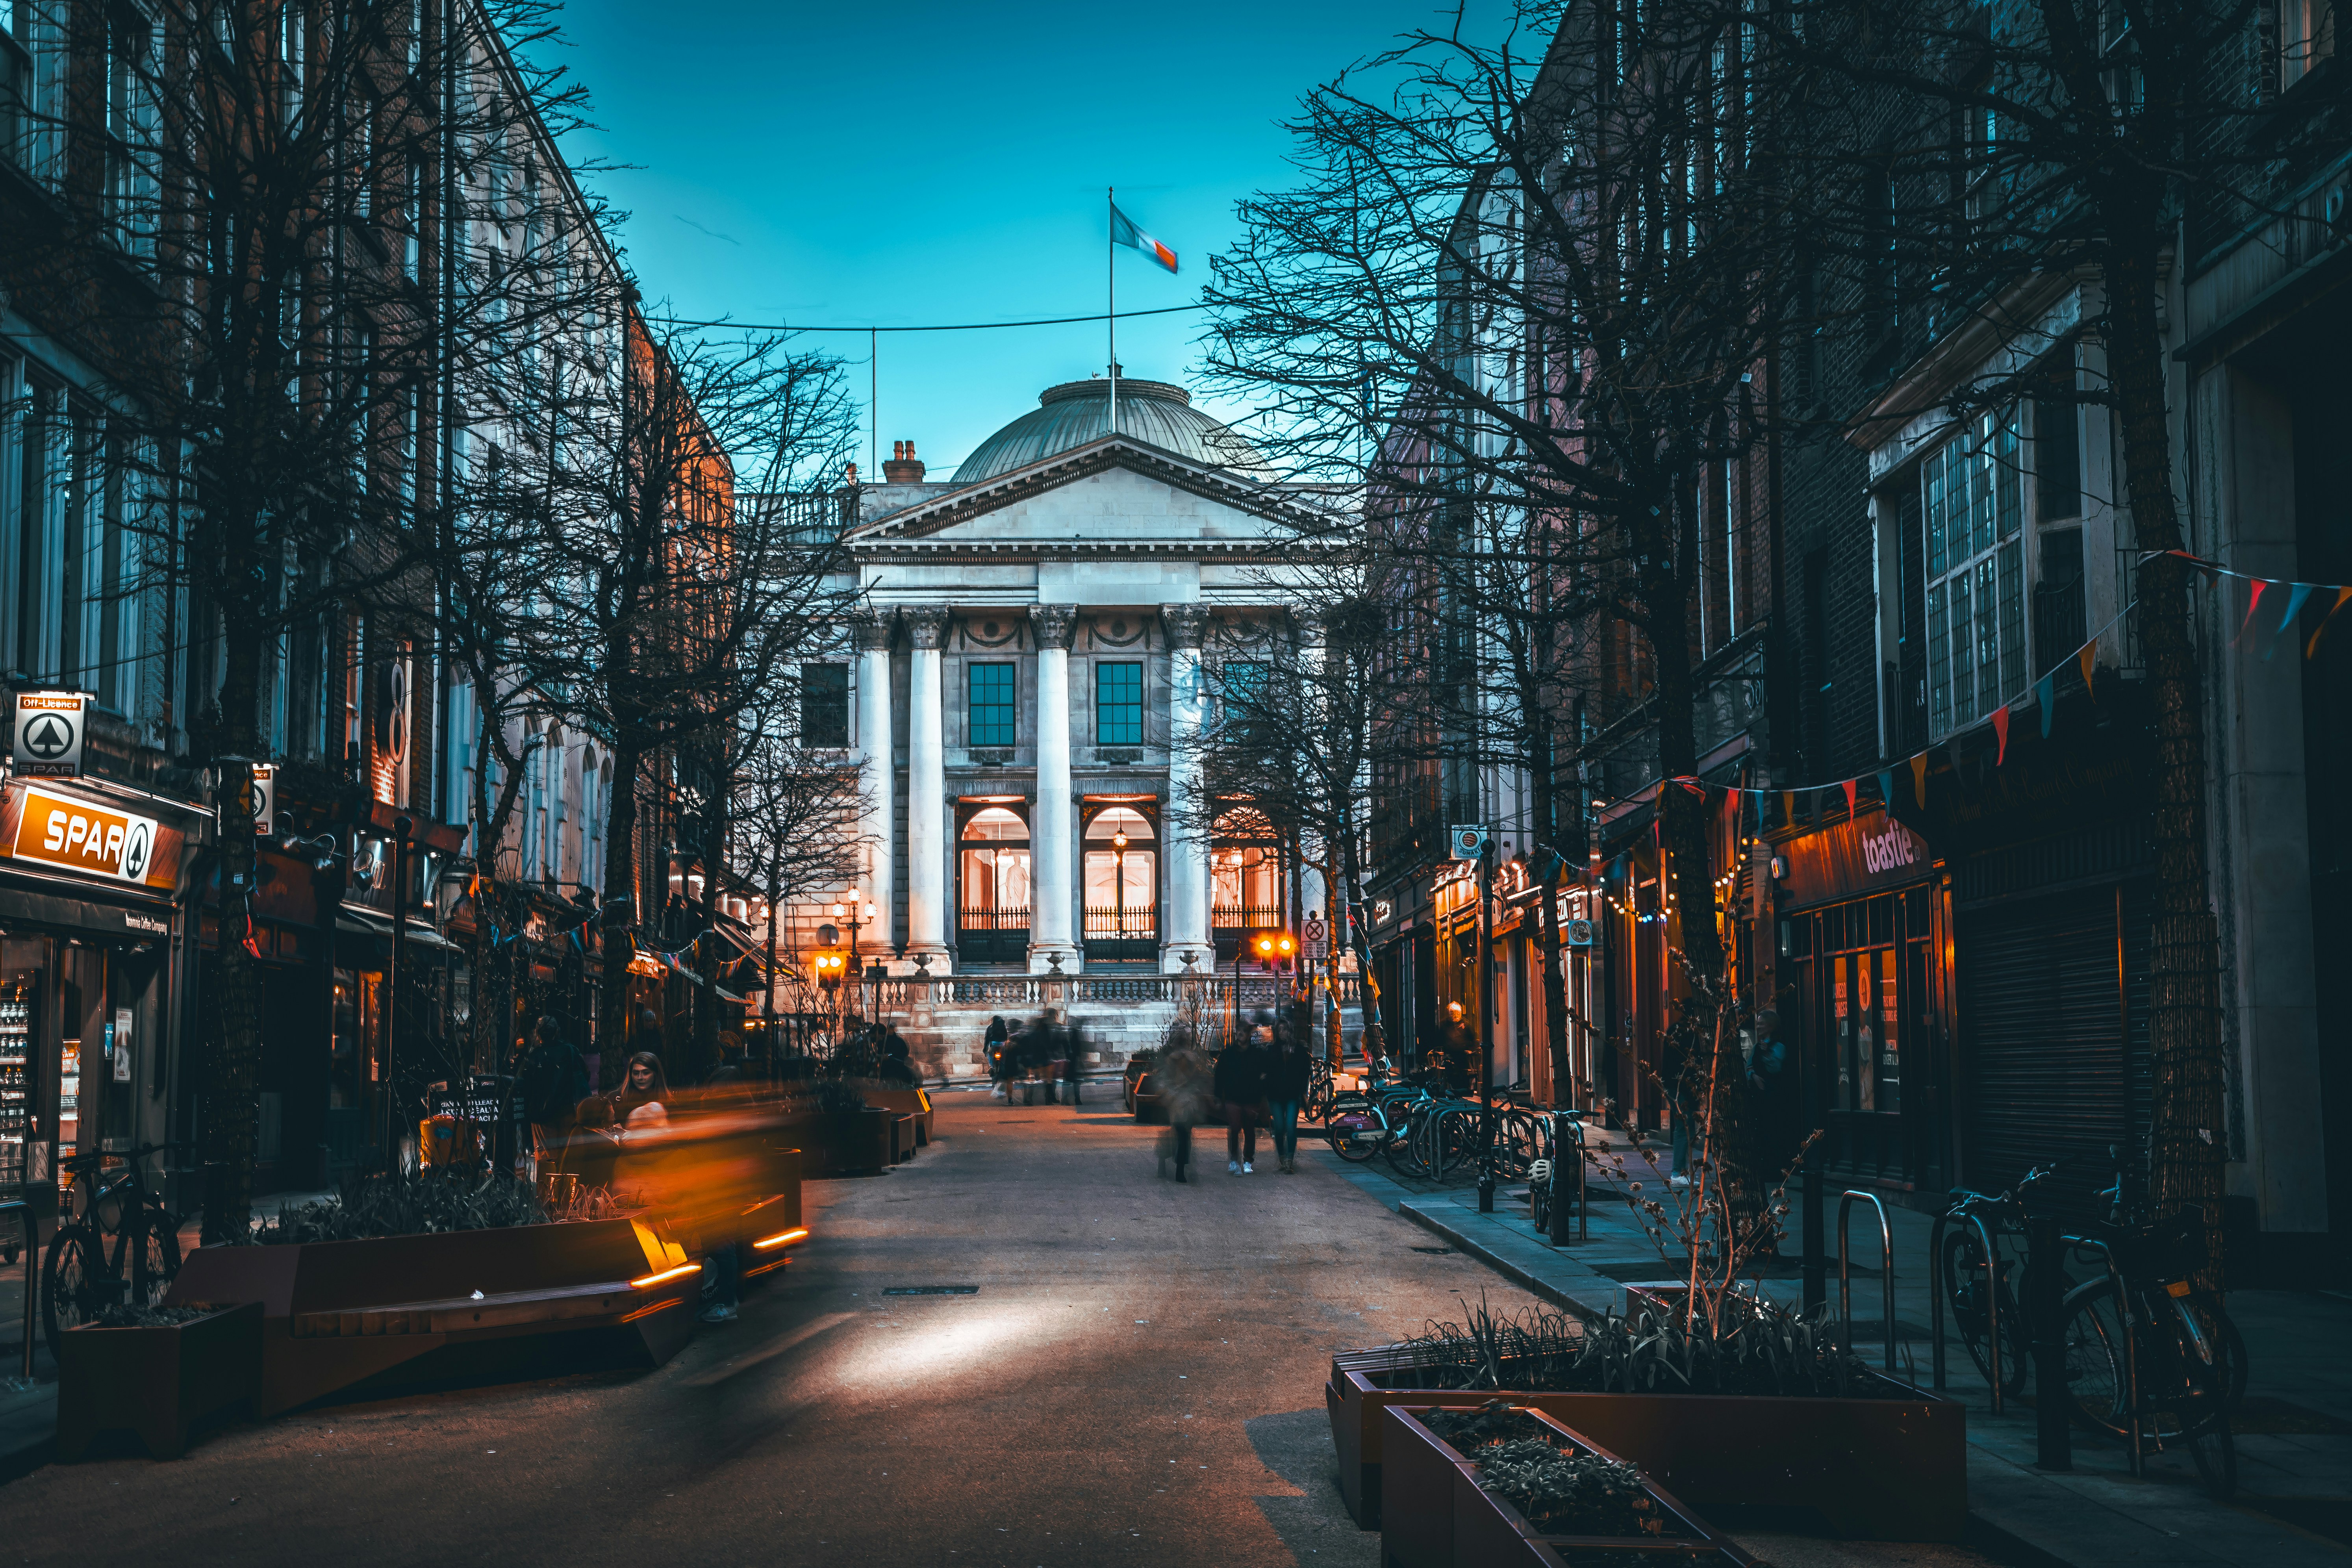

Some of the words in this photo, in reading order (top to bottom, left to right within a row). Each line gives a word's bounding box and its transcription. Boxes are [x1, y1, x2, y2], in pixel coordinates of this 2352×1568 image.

[23, 698, 78, 709] Off-Licence
[19, 764, 74, 775] SPAR
[44, 810, 125, 865] SPAR
[1459, 847, 1481, 856] SUMAKI
[1862, 819, 1914, 874] toastie
[1833, 982, 1847, 999] JAMESO
